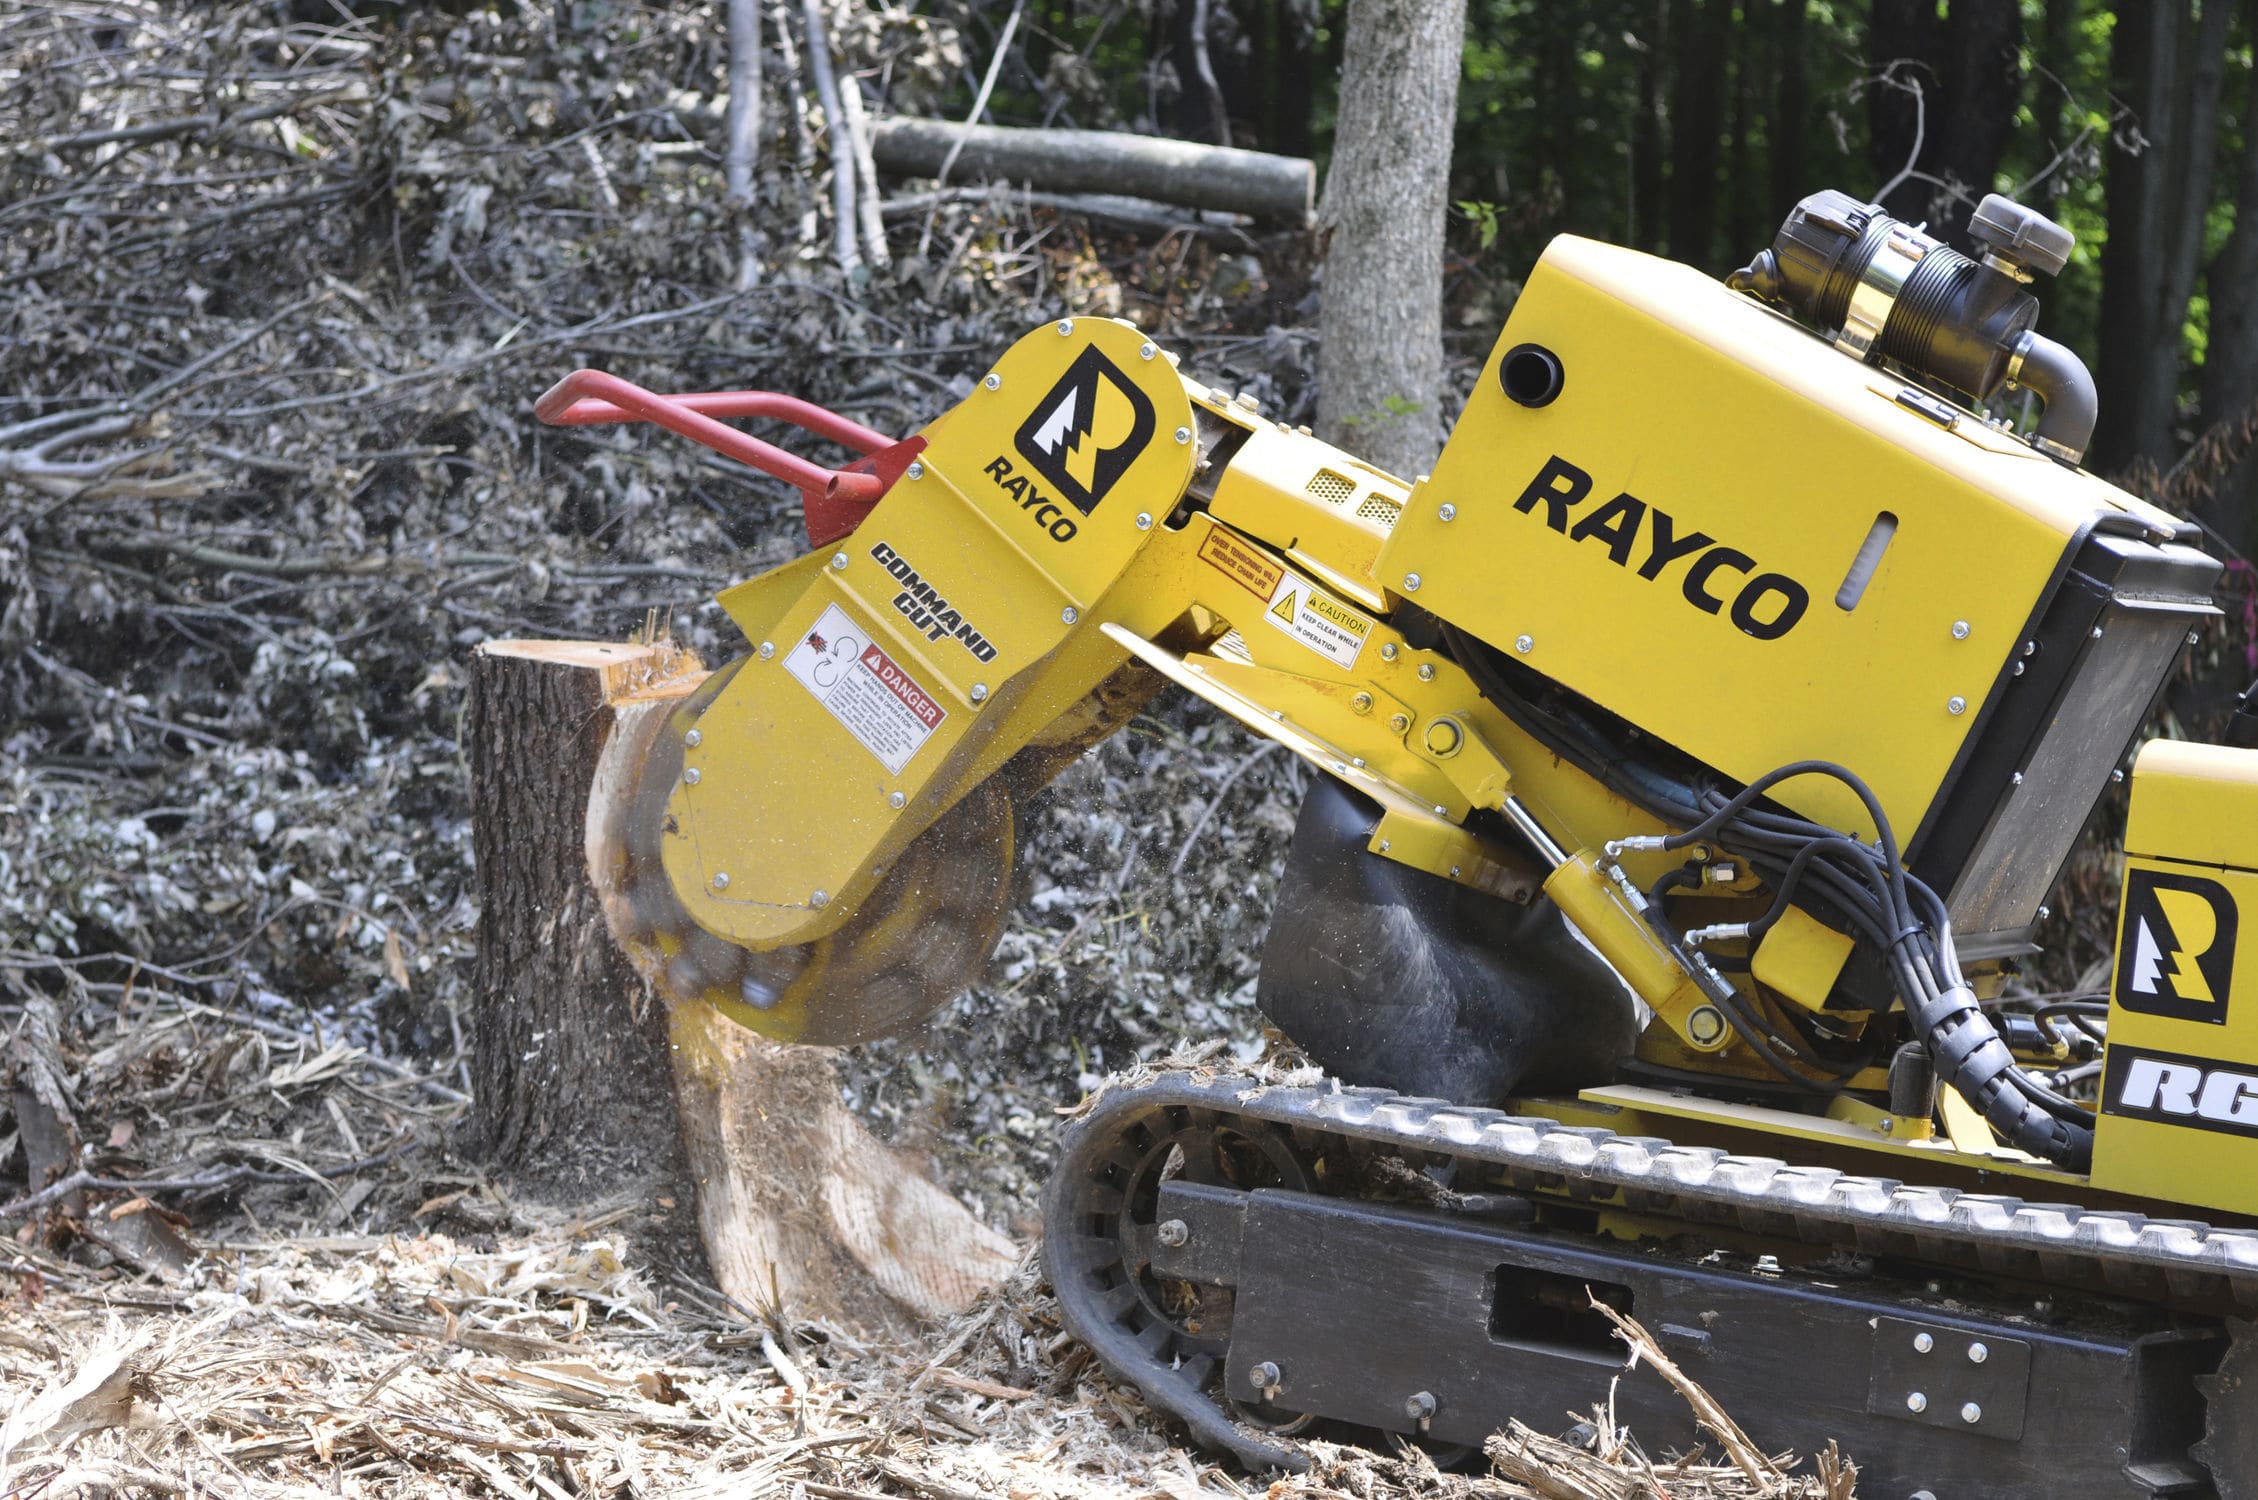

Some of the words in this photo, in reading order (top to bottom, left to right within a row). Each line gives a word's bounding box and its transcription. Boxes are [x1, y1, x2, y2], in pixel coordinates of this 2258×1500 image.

[982, 455, 1078, 543] RAYCO
[1210, 534, 1229, 550] OVER
[1261, 569, 1277, 583] WILL
[1210, 547, 1237, 568] REDUCE
[1236, 565, 1254, 580] CHAIN
[1253, 576, 1267, 589] LIFE
[1512, 454, 1810, 641] RAYCO
[870, 541, 998, 665] COMMAND
[892, 591, 951, 644] CUT
[1317, 600, 1367, 636] CAUTION
[1294, 624, 1302, 633] IN
[1301, 628, 1337, 653] OPERATION
[1300, 611, 1317, 625] KEEP
[1315, 620, 1338, 637] CLEAR
[1336, 631, 1359, 649] WHILE
[856, 663, 870, 678] KEEP
[869, 676, 887, 695] HANDS
[904, 711, 926, 733] MACHINE
[862, 680, 878, 696] WHILE
[877, 694, 884, 702] IN
[883, 700, 912, 729] OPERATION
[879, 664, 938, 722] DANGER
